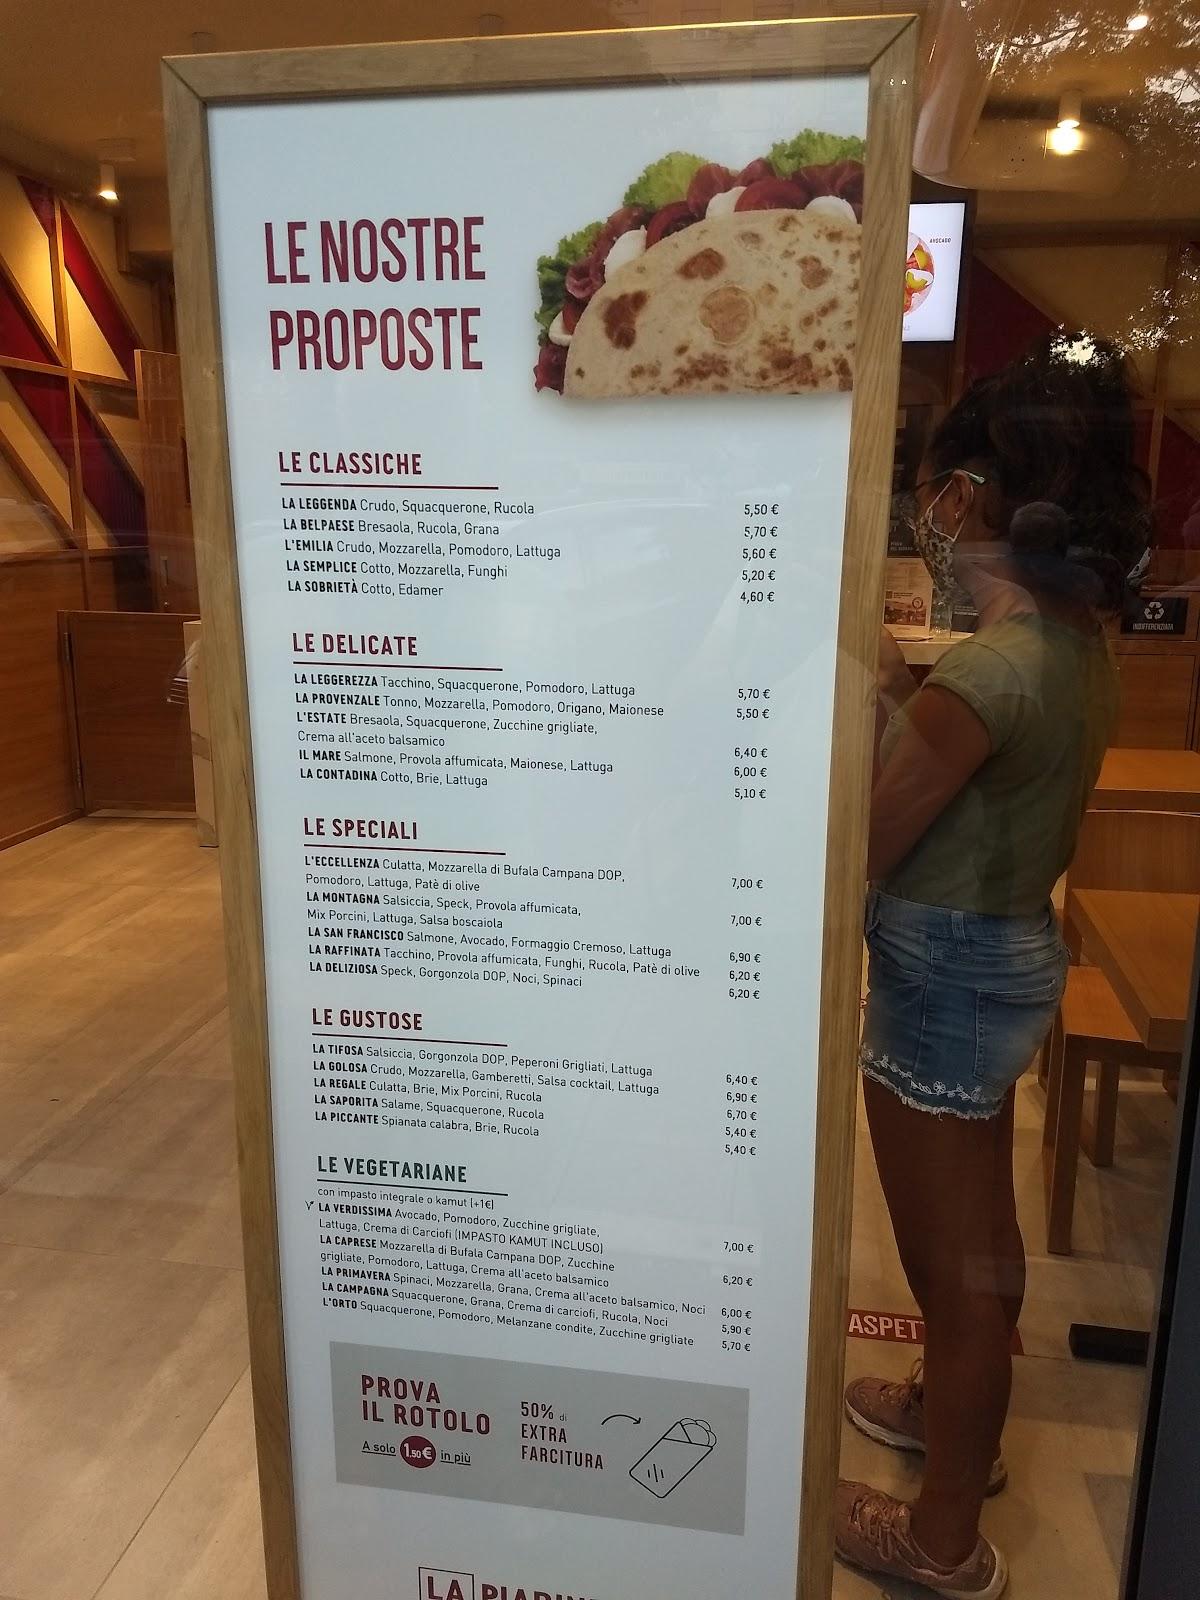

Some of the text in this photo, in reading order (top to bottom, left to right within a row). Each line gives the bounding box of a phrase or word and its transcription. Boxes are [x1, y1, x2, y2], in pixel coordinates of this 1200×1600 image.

[265, 216, 485, 283] LE NOSTRE
[269, 307, 483, 371] PROPOSTE
[277, 450, 422, 475] LE CLASSICHE
[281, 496, 534, 516] LA LEGGENDA Crudo, Squacquerone, Rucola
[743, 503, 779, 518] 5,50 €
[282, 517, 499, 536] LA BELPAESE Bresaola, Rucola, Grana
[743, 525, 778, 540] 5,70 €
[284, 538, 561, 561] L'EMILIA Crudo, Mozzarella, Pomodoro, Lattuga
[741, 547, 777, 561] 5,60 €
[285, 559, 507, 580] LA SEMPLICE Cotto, Mozzarella, Funghi
[741, 569, 776, 583] 5,20 €
[287, 577, 444, 596] LA SOBRIETÀ Cotto, Edamer
[739, 590, 775, 604] 4,60 €
[291, 631, 418, 656] LE DELICATE
[293, 672, 635, 698] LA LEGGEREZZA Tacchino, Squacquerone, Pomodoro, Lattuga
[737, 687, 771, 701] 5,70 €
[294, 691, 664, 717] LA PROVENZALE Tonno, Mozzarella, Pomodoro, Origano, Maionese
[298, 748, 613, 775] IL MARE Salmone, Provola affumicata, Maionese, Lattuga
[733, 765, 767, 779] 6,00 €
[299, 767, 488, 789] LA CONTADINA Cotto, Brie, Lattuga
[303, 816, 417, 840] LE SPECIALI
[304, 855, 625, 882] L'ECCELLENZA Culatta, Mozzarella di Bufala Campana DOP,
[731, 877, 763, 890] 7,00 €
[307, 926, 671, 959] LA SAN FRANCISCO Salmone, Avocado, Formaggio Cremoso, Lattuga
[308, 960, 582, 987] LA DELIZIOSA Speck, Gorgonzola DOP, Noci, Spinaci
[311, 1007, 423, 1031] LE GUSTOSE
[312, 1042, 652, 1079] LA TIFOSA Salsiccia, Gorgonzola DOP, Peperoni Grigliati, Lattuga
[725, 1073, 758, 1086] 6,40 €
[314, 1093, 544, 1120] LA SAPORITA Salame, Squacquerone, Rucola
[317, 1155, 467, 1183] LE VEGETARIANE
[318, 1201, 600, 1238] LA VERDISSIMA Avocado, Pomodoro, Zucchine grigliate,
[723, 1240, 754, 1253] 7,00 €
[322, 1296, 694, 1346] L'ORTO Squacquerone, Pomodoro, Melanzane condite, Zucchine grigliate
[721, 1323, 751, 1336] 5,90 €
[848, 1313, 925, 1339] ASPET
[721, 1339, 751, 1352] 5,70 €
[361, 1374, 441, 1404] PROVA
[362, 1400, 490, 1435] IL ROTOLO
[521, 1401, 568, 1422] 50% di
[521, 1423, 567, 1444] EXTRA
[362, 1440, 371, 1451] A
[373, 1442, 396, 1454] solo
[440, 1449, 451, 1461] in
[454, 1451, 471, 1464] più
[521, 1444, 604, 1470] FARCITURA
[427, 1575, 465, 1600] LA
